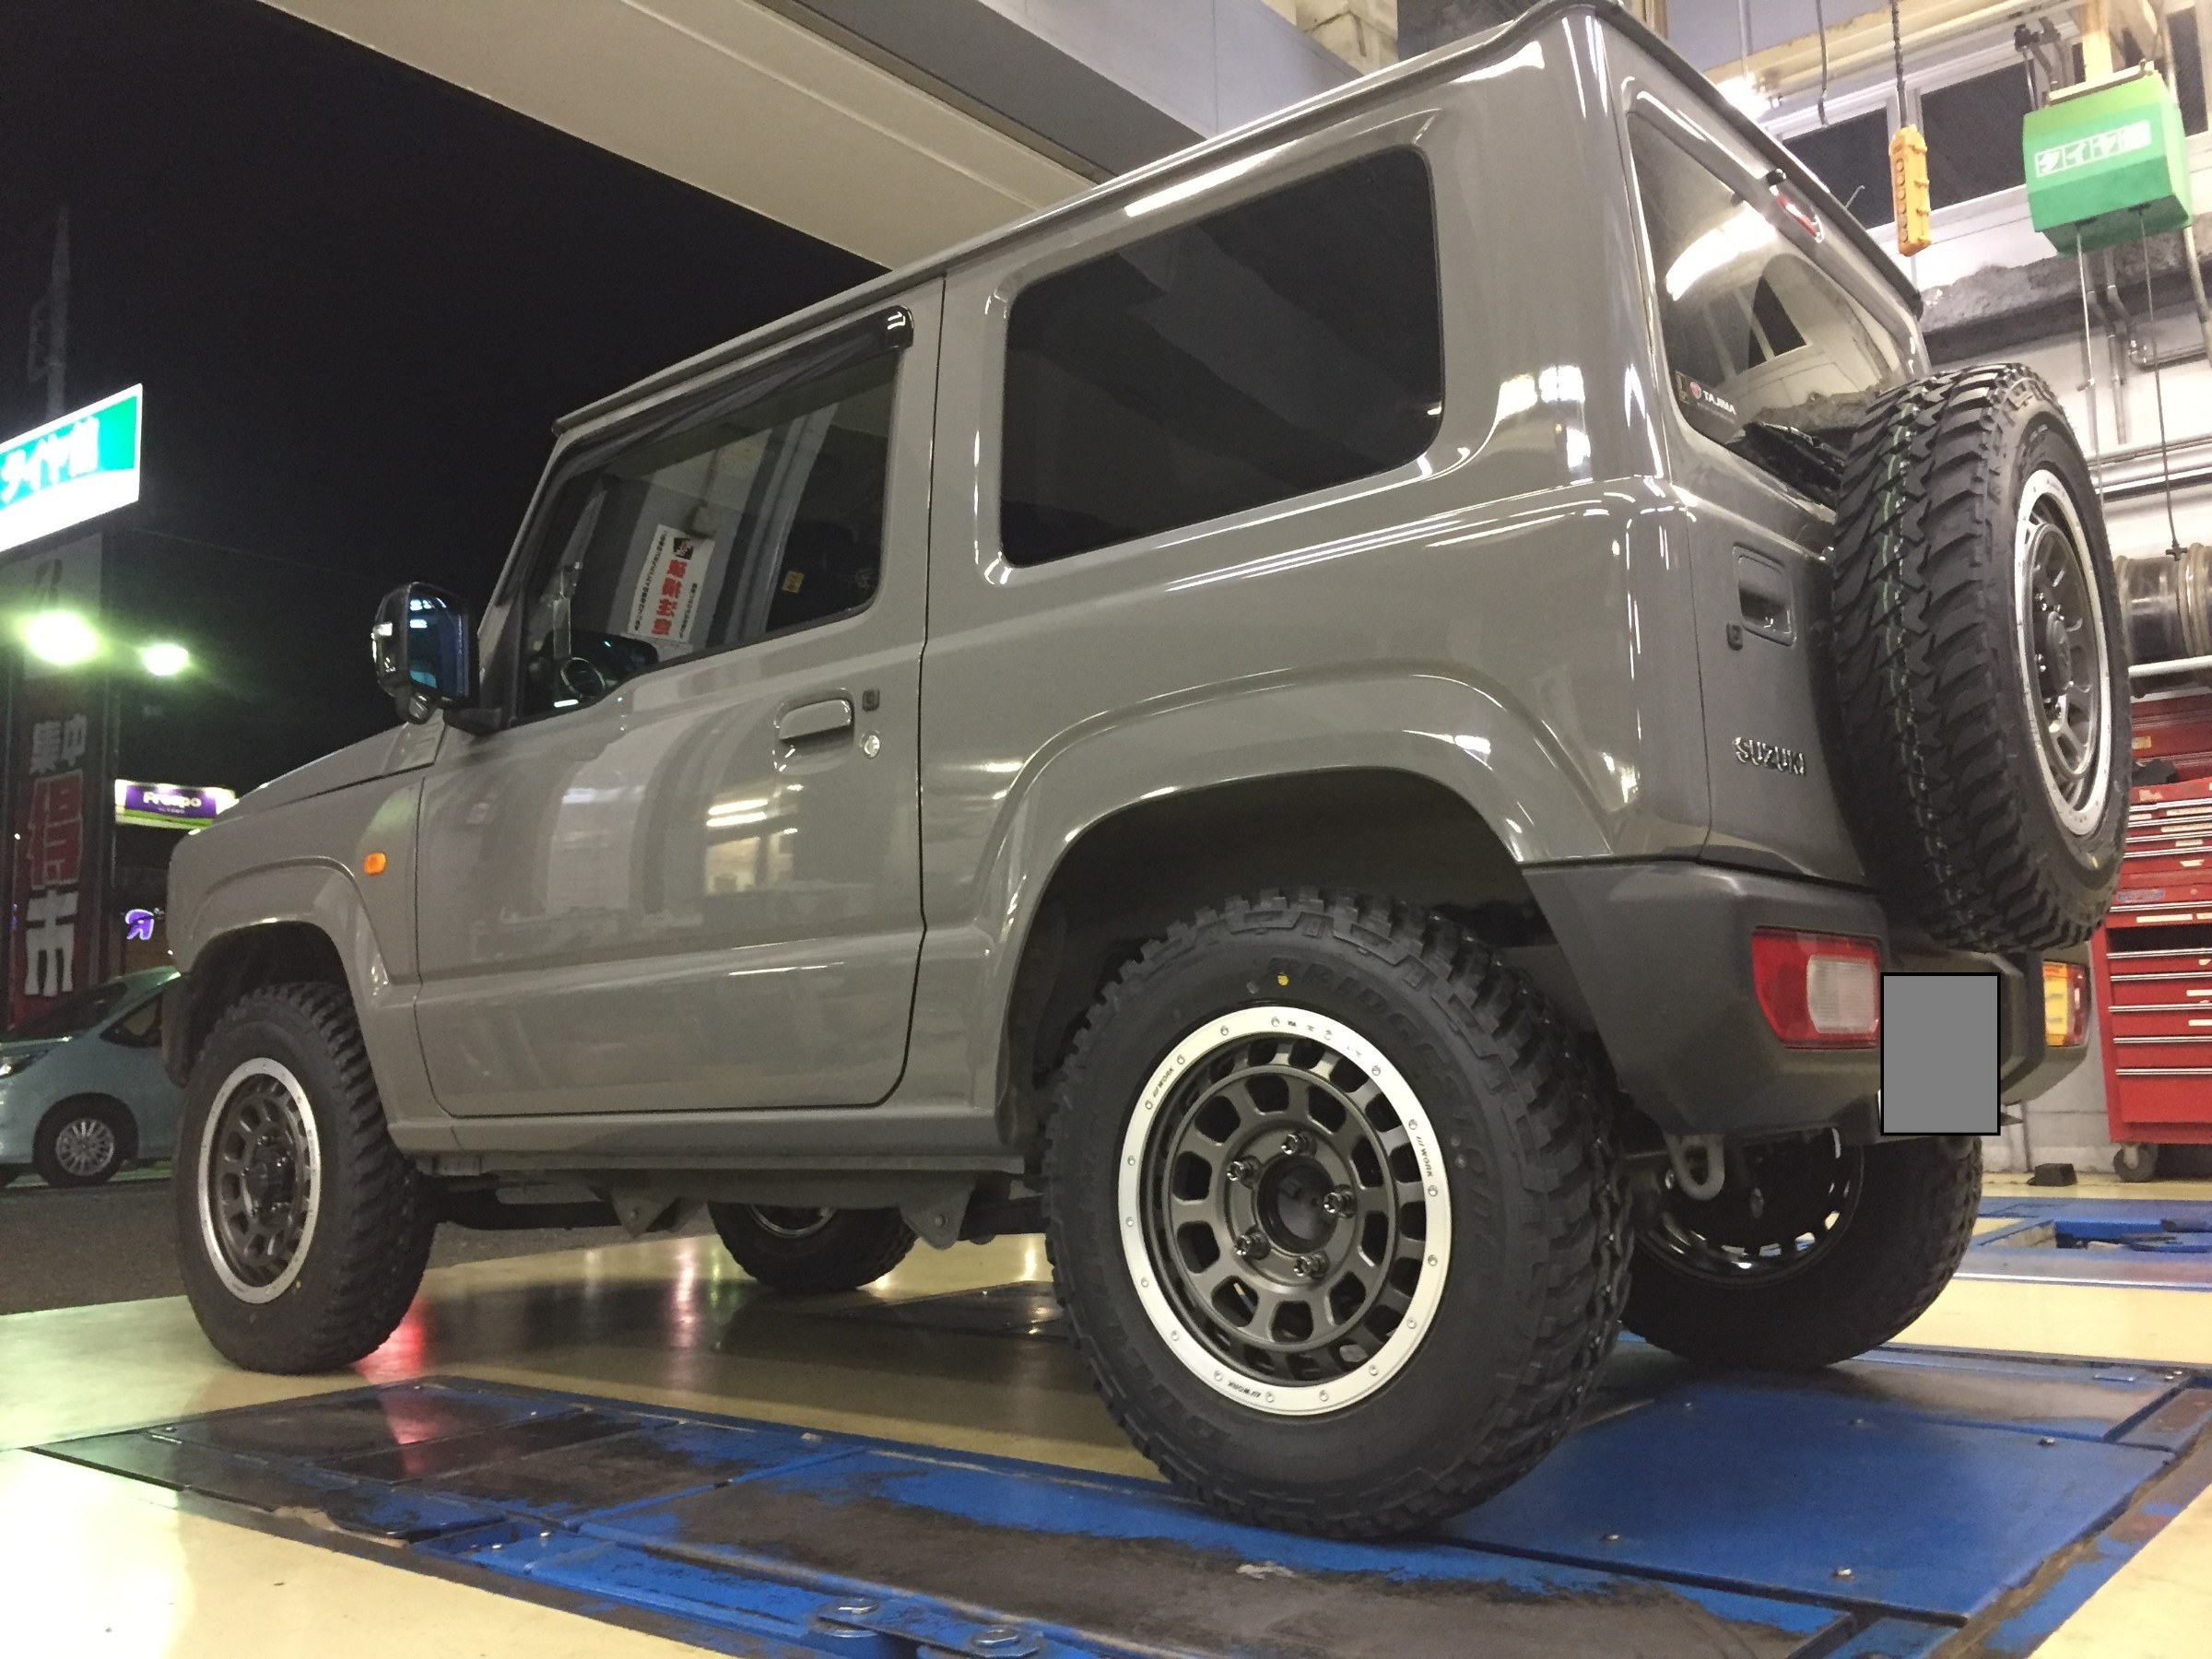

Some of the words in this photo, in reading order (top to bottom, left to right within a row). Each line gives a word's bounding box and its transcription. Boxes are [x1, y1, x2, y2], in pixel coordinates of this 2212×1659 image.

[2037, 121, 2151, 175] タイヤ
[1702, 390, 1736, 415] TAJIMA
[1733, 736, 1806, 776] SUZUKI
